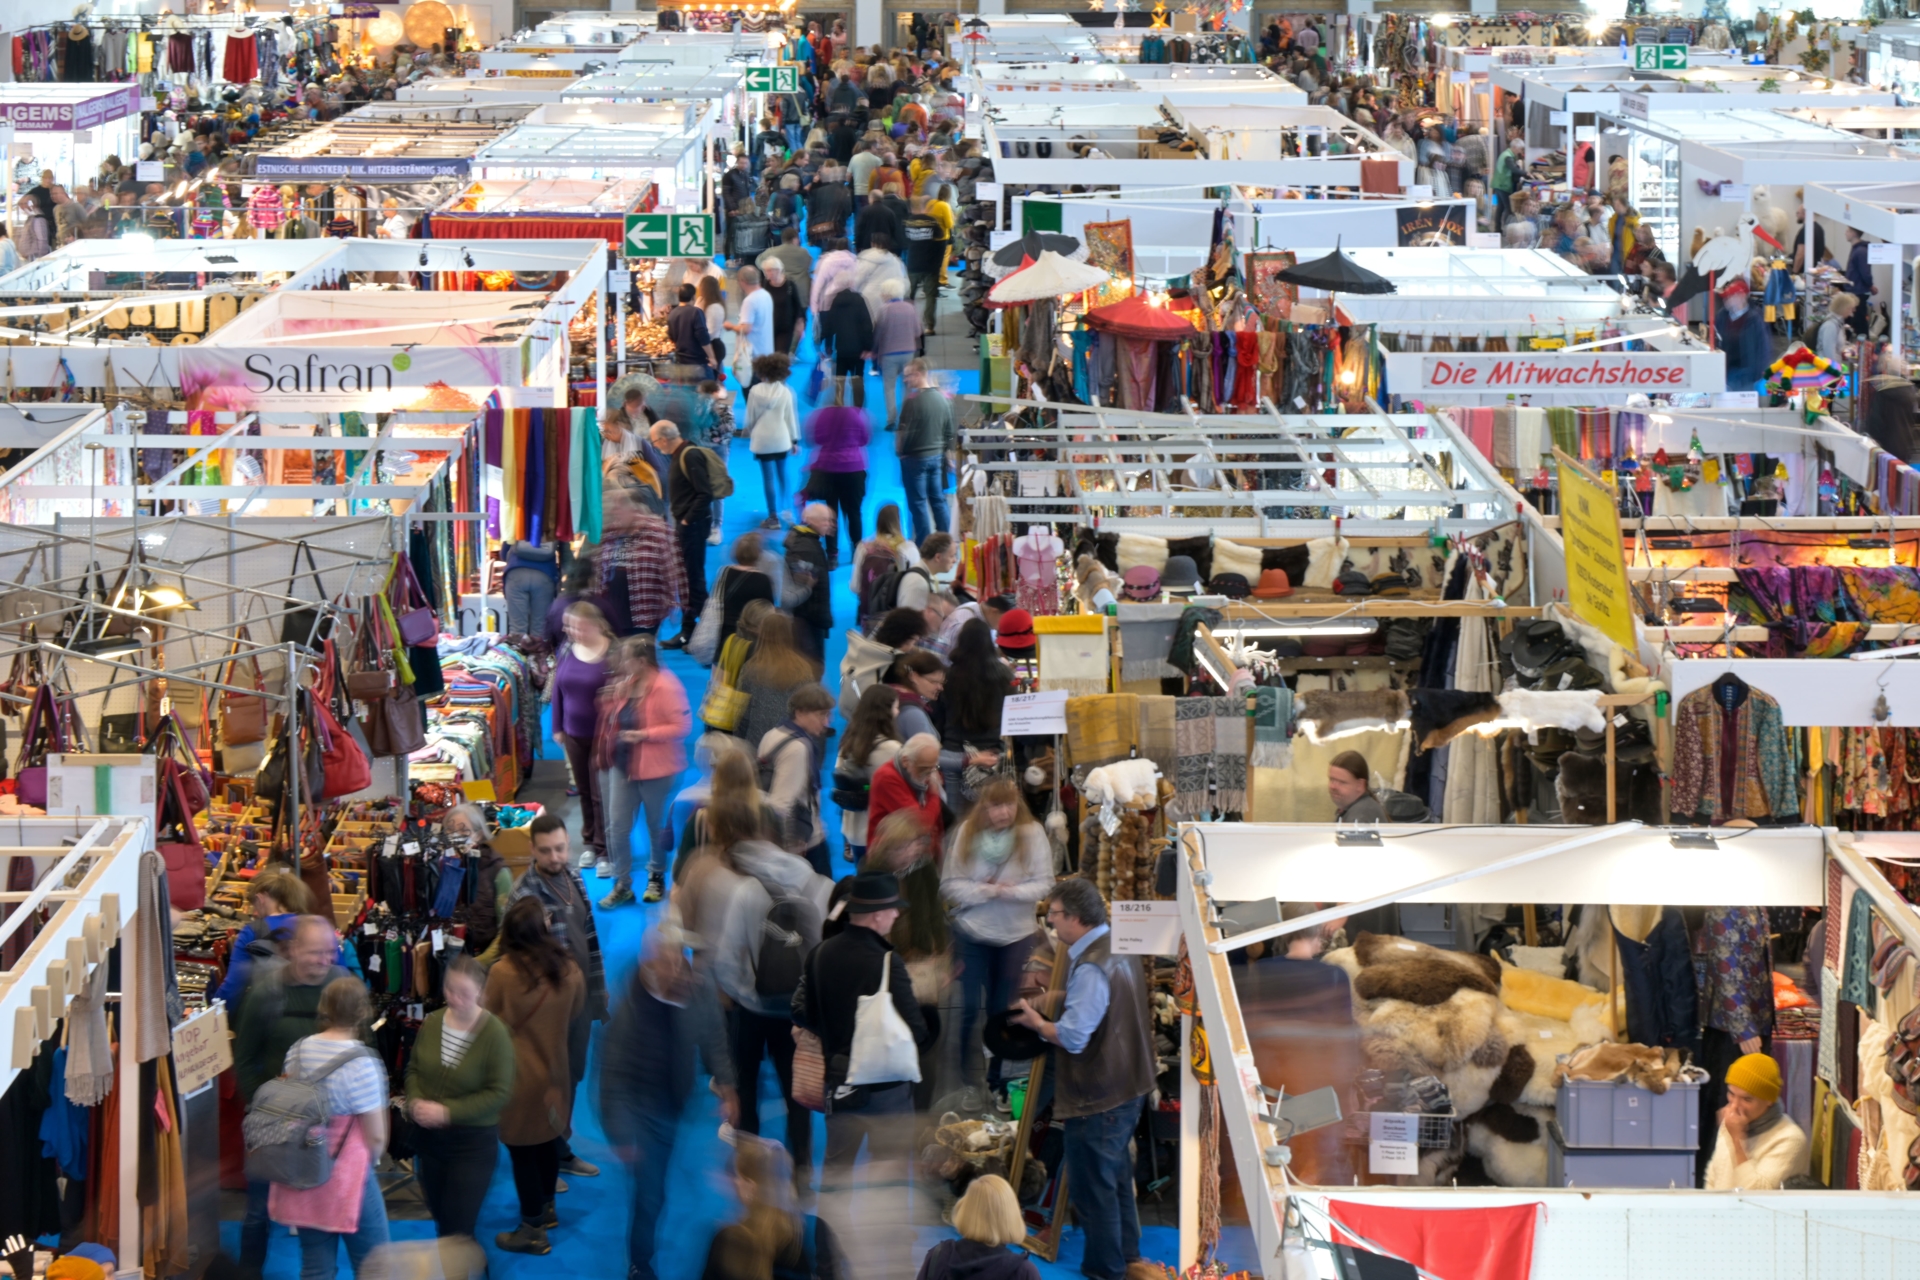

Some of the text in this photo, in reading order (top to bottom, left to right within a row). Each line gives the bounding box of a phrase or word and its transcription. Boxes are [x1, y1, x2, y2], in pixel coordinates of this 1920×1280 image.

[15, 121, 54, 130] ERMANY
[257, 164, 300, 174] ESTNISCHE
[368, 163, 436, 175] HITZEBESTÄNDIG
[1401, 217, 1433, 235] IREN
[244, 353, 392, 393] Safran
[1431, 359, 1685, 385] Die Mitwachshose
[1011, 694, 1036, 703] 18/217
[1119, 903, 1152, 912] 18/216
[178, 1026, 200, 1045] TOP
